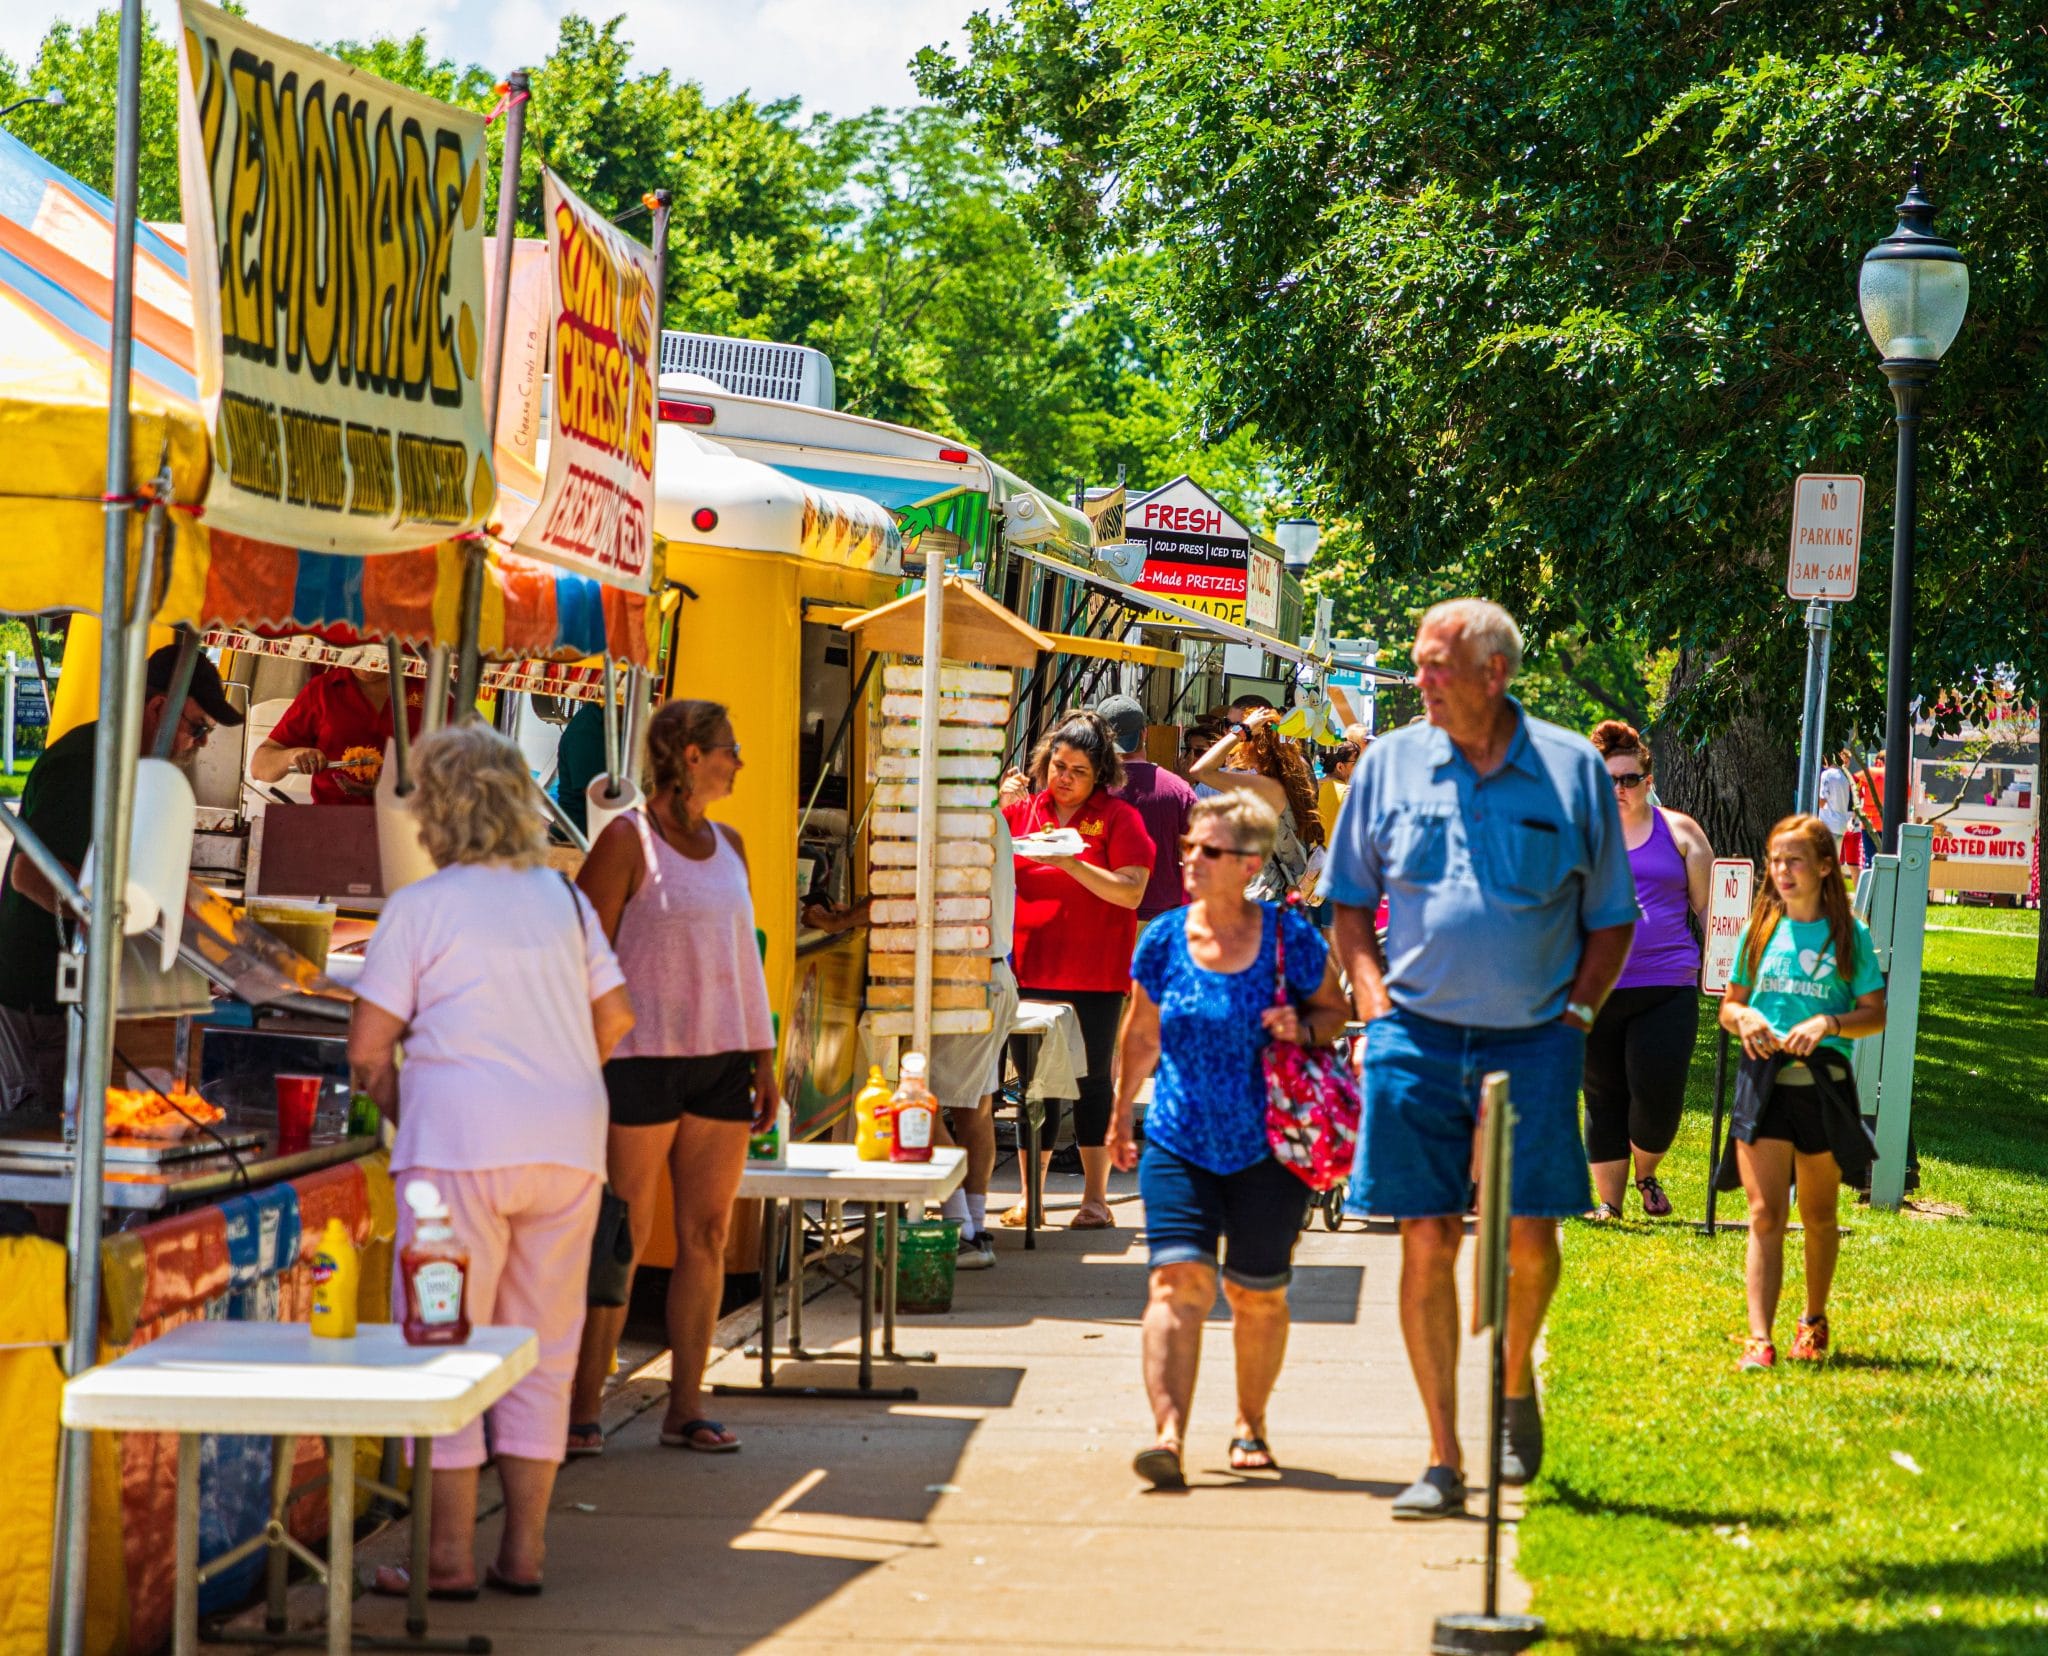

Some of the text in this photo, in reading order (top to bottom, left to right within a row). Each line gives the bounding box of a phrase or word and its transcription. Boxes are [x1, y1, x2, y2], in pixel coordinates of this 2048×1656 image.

[199, 36, 466, 409] LEMONADE
[1821, 493, 1838, 511] NO
[1144, 503, 1222, 534] FRESH
[1800, 528, 1853, 546] PARKING
[1154, 541, 1177, 552] COLD
[1178, 543, 1204, 555] PRESS
[1211, 547, 1229, 557] ICED
[1231, 549, 1247, 559] TEA
[1137, 567, 1182, 587] d-Made
[1186, 573, 1246, 593] PRETZELS
[1794, 562, 1852, 580] 3AM-6AM
[1967, 825, 1995, 836] Fresh
[1932, 837, 2026, 858] OASTED NUTS
[1725, 878, 1739, 899] NO
